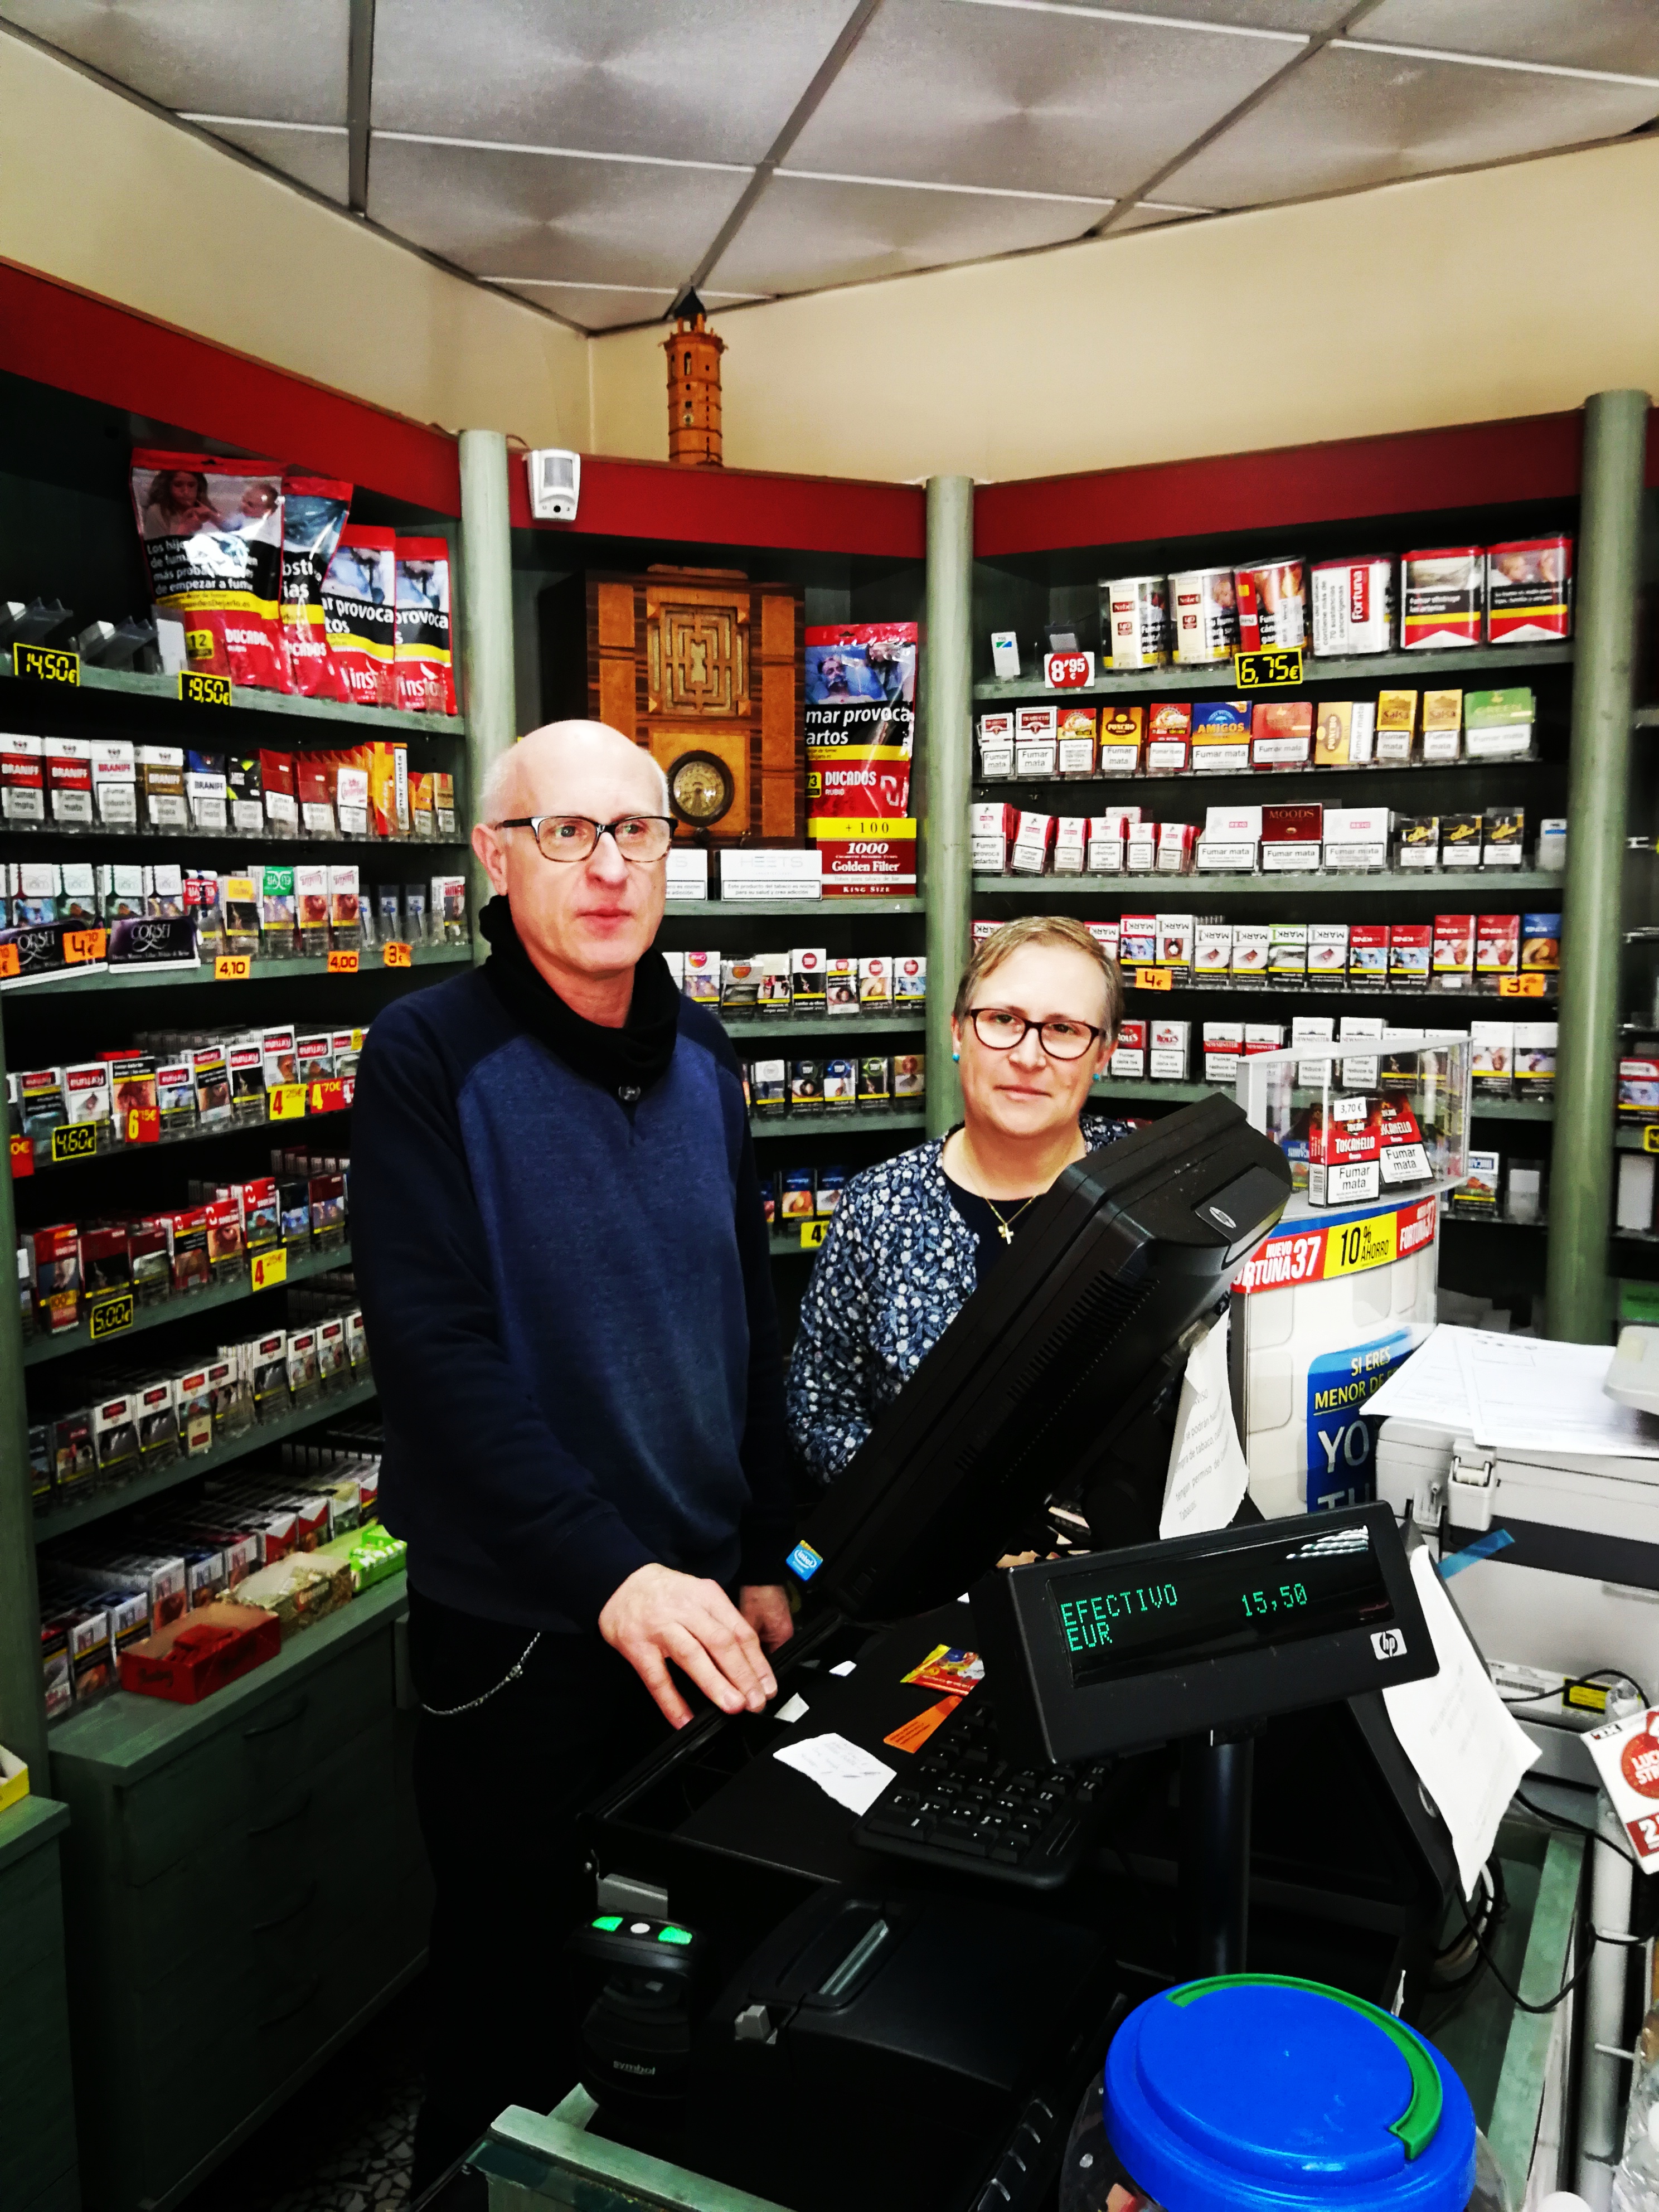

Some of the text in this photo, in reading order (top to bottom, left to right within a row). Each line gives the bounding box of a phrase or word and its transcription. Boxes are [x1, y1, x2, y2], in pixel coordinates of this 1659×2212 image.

[169, 579, 216, 591] empezar
[1351, 570, 1364, 620] Fortuna
[335, 599, 395, 623] provoca
[26, 652, 76, 684] 14,50€
[1241, 654, 1299, 685] 6,75€
[188, 677, 229, 706] 19,50€
[843, 707, 911, 727] provoca
[1197, 722, 1245, 734] AMIGOS
[984, 753, 1008, 761] Fumar
[1022, 750, 1049, 759] Fumar
[1195, 750, 1223, 758] Fumar
[1024, 759, 1046, 767] mata
[824, 771, 877, 787] DUCADOS
[1269, 809, 1315, 820] MOODS
[846, 842, 889, 855] 1000
[1201, 847, 1250, 856] Fumar mata
[1266, 849, 1316, 858] Fumar mata
[832, 860, 899, 872] Golden Filter
[219, 961, 245, 977] 4,10
[329, 956, 357, 971] 4,00
[1144, 971, 1156, 988] 4
[273, 1090, 283, 1115] 4
[312, 1084, 323, 1110] 4
[1340, 1104, 1356, 1114] 3,70
[129, 1109, 139, 1140] 6
[1335, 1136, 1375, 1154] TOSCANELLO
[1386, 1147, 1416, 1161] Fumar
[1339, 1166, 1370, 1180] Fumar
[1393, 1158, 1417, 1171] mata
[1342, 1177, 1366, 1190] mata
[1265, 1240, 1293, 1259] NUEVO
[1340, 1226, 1361, 1267] 10
[1291, 1236, 1322, 1279] 37
[255, 1259, 265, 1285] 4
[1350, 1356, 1362, 1377] SI
[1365, 1346, 1391, 1373] ERES
[1314, 1379, 1366, 1410] MENOR
[1317, 1420, 1370, 1474] YO
[1060, 1583, 1308, 1627] EFECTIVO 15,50
[1066, 1621, 1113, 1651] EUR
[1381, 1634, 1396, 1657] hp
[613, 2060, 656, 2075] symbol
